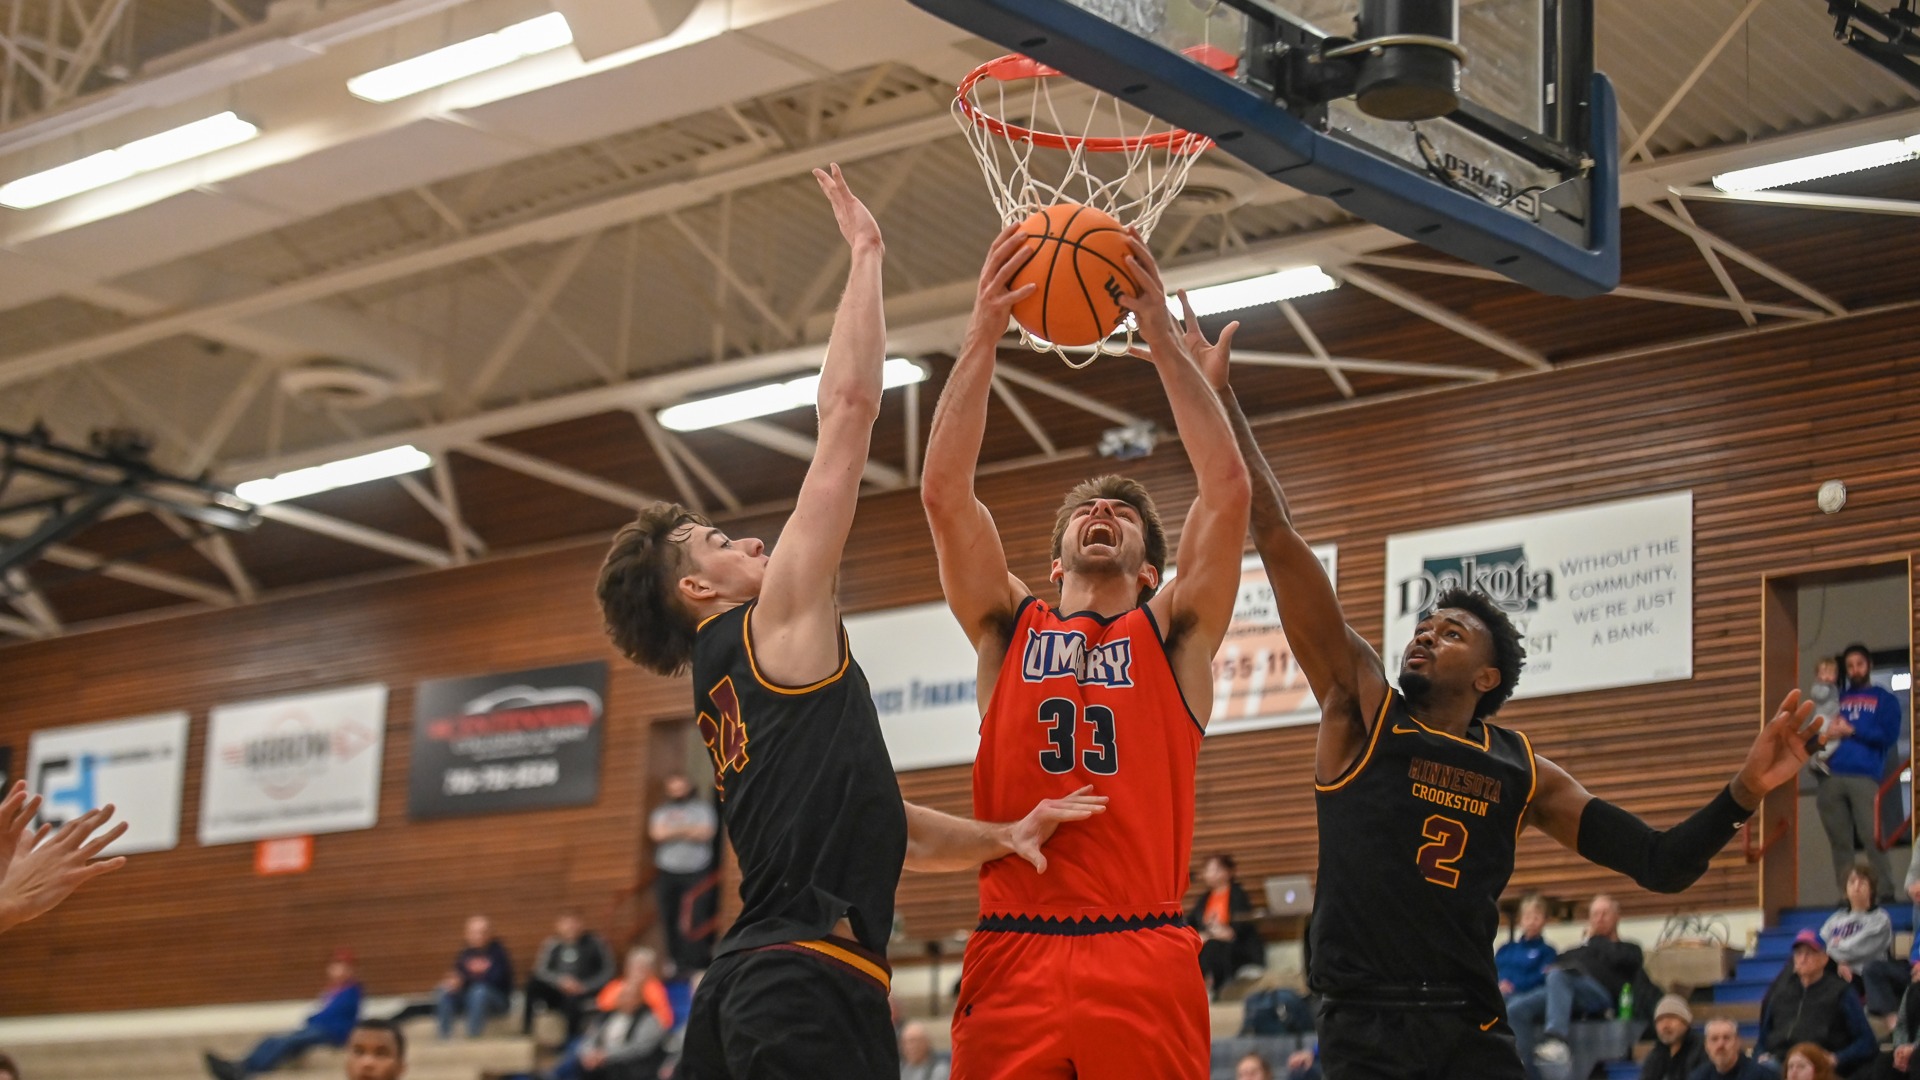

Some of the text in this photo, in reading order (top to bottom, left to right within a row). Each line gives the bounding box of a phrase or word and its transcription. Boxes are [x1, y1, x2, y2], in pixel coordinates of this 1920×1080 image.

[1559, 537, 1680, 578] WITHOUT THE
[1572, 589, 1677, 625] WE'RE JUST
[1022, 627, 1135, 688] UMARY
[1591, 630, 1603, 647] A
[1038, 696, 1119, 776] 33
[1407, 755, 1502, 804] MINNESOTA
[1411, 782, 1489, 818] CROOKSTON
[1416, 813, 1469, 889] 2
